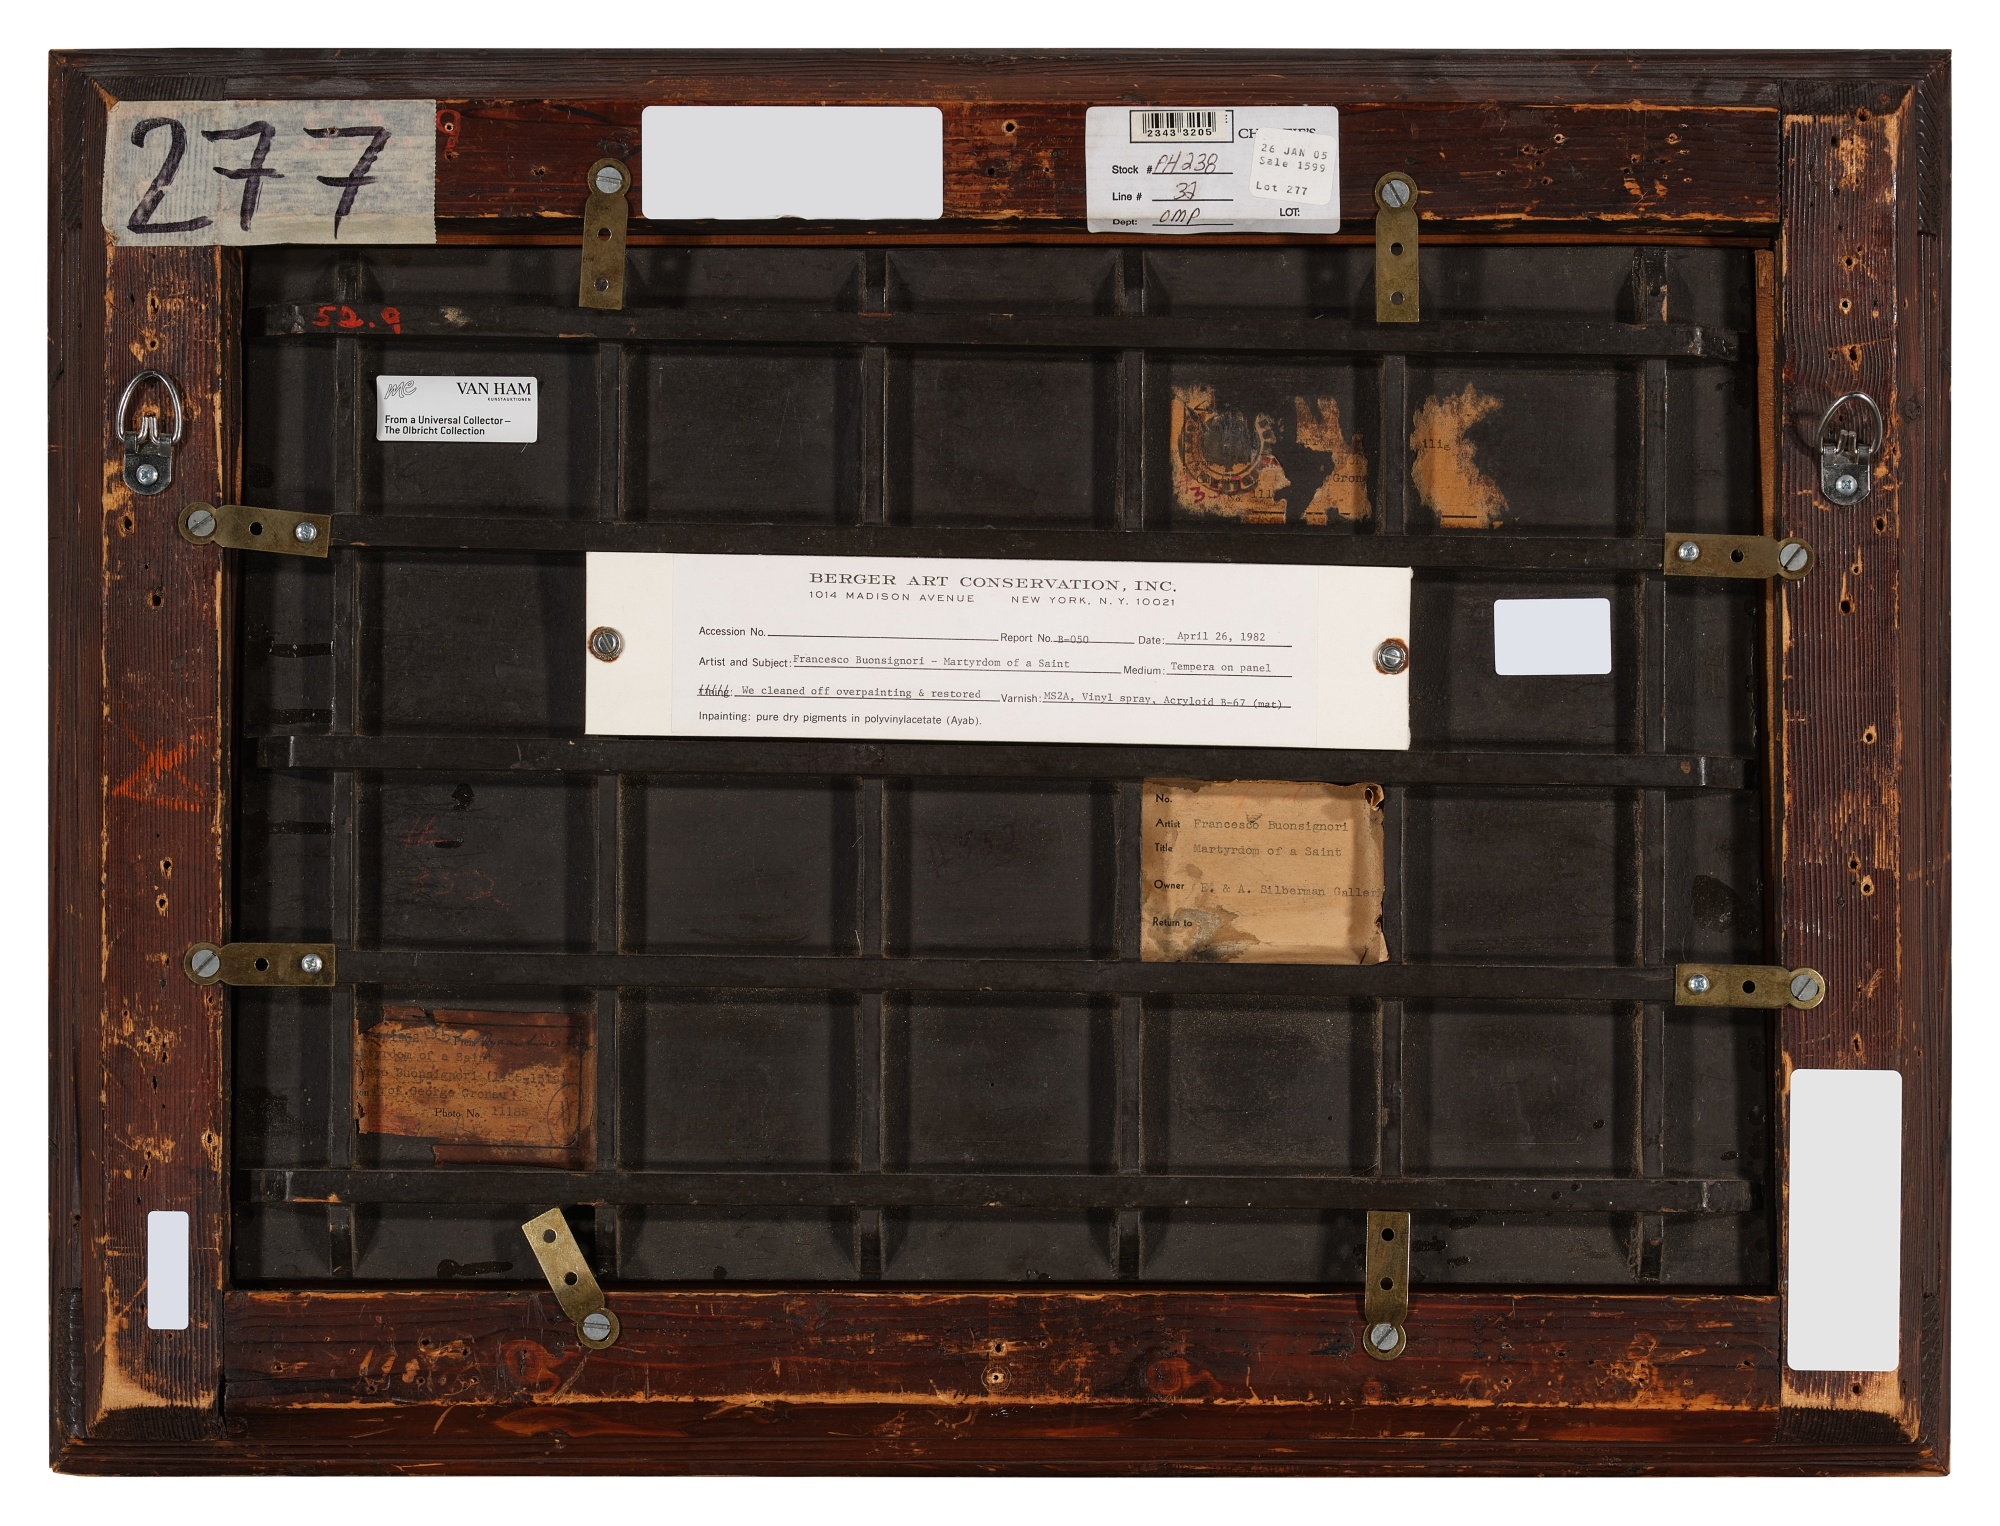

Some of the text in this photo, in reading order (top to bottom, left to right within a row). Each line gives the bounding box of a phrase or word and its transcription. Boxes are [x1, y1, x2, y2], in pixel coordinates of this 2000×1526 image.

[1147, 128, 1213, 137] 2343 3205
[1261, 143, 1328, 160] 26 JAN 05
[1112, 165, 1139, 174] Stock
[1259, 156, 1326, 173] Sale 1599
[127, 116, 392, 240] 277
[1256, 181, 1308, 195] Lot 277
[1112, 192, 1132, 201] Line
[1279, 207, 1300, 217] LOT:
[1112, 219, 1137, 227] Dept:
[456, 382, 531, 395] VAN HAM
[385, 415, 408, 424] From
[418, 415, 461, 425] Universal
[385, 426, 485, 435] The Olbricht Collection
[809, 572, 1177, 592] BERGER ART CONSERVATION, INC.
[809, 591, 975, 602] 1014 MADISON AVENUE
[1011, 596, 1040, 604] NEW
[1049, 596, 1091, 605] YORK,
[1136, 598, 1175, 606] 10021
[699, 627, 766, 637] Accession No.
[1138, 631, 1265, 645] Date: April 26, 1982
[1000, 633, 1089, 644] Report No. B-050
[699, 657, 725, 667] Artist
[730, 658, 748, 667] and
[752, 658, 792, 669] Subject:
[793, 655, 849, 664] Francesco
[856, 656, 924, 666] Buonsignori
[944, 657, 1001, 668] Martyrdom
[1007, 658, 1020, 667] of
[1038, 659, 1070, 669] Saint
[1123, 666, 1165, 676] Medium:
[1171, 662, 1215, 673] Tempera
[1240, 663, 1272, 674] panel
[742, 686, 754, 695] We
[761, 686, 805, 696] cleaned
[811, 686, 830, 696] off
[836, 687, 912, 698] overpainting
[918, 689, 925, 697] &
[931, 690, 981, 699] restored
[1001, 692, 1282, 709] Varnish: MS2A, Vinyl spray, Acryloid B-67 (mat)
[699, 711, 982, 726] Inpainting: pure dry pigments in polyvinylacetate (Ayab).
[1155, 793, 1173, 803] No.
[1155, 819, 1349, 833] Artist Francesco Buonsignori
[1154, 843, 1173, 852] Title
[1193, 843, 1260, 857] Martyrdom
[1267, 846, 1282, 856] of
[1305, 846, 1342, 857] Saint
[1153, 880, 1185, 890] Owner
[1200, 883, 1215, 894] E.
[1222, 884, 1231, 893] &
[1238, 884, 1252, 894] A.
[1260, 885, 1325, 896] Silberman
[1152, 917, 1193, 927] Return to
[419, 1050, 434, 1061] of
[441, 1053, 449, 1061] a
[435, 1107, 461, 1118] Photo
[466, 1108, 481, 1118] No.
